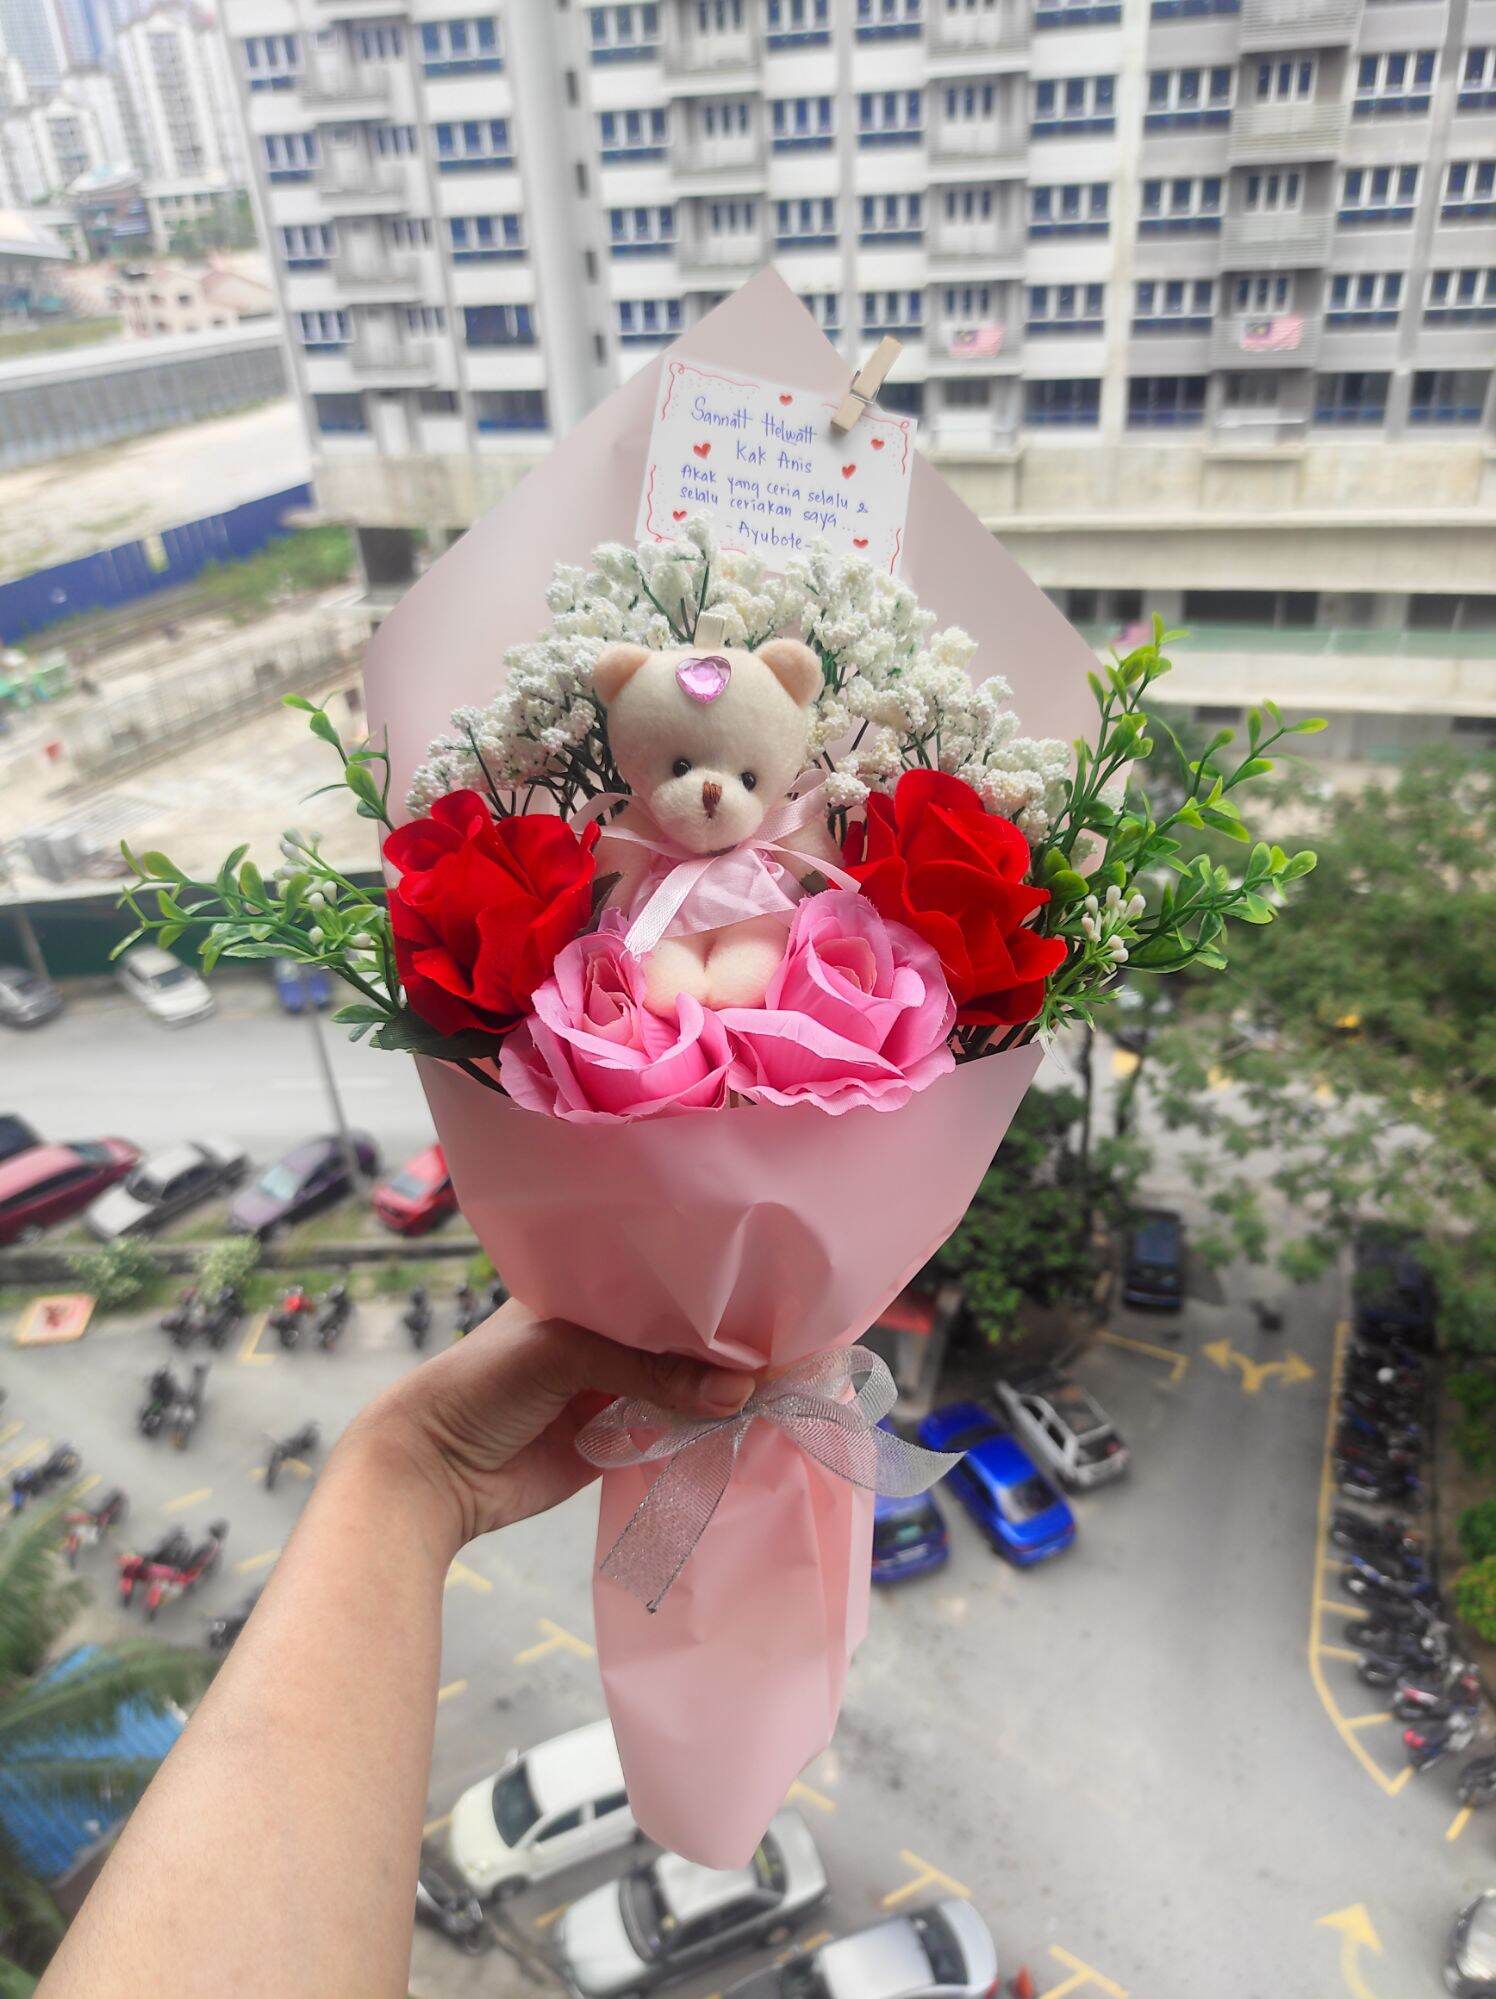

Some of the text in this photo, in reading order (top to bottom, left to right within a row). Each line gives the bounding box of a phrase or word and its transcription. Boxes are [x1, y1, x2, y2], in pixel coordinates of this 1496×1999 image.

[736, 440, 813, 474] Kak Anis
[680, 486, 718, 505] selalu
[730, 498, 792, 517] ceriakan
[681, 464, 717, 483] Akak
[727, 476, 760, 497] yang
[766, 480, 801, 499] ceria
[808, 488, 849, 509] selalu
